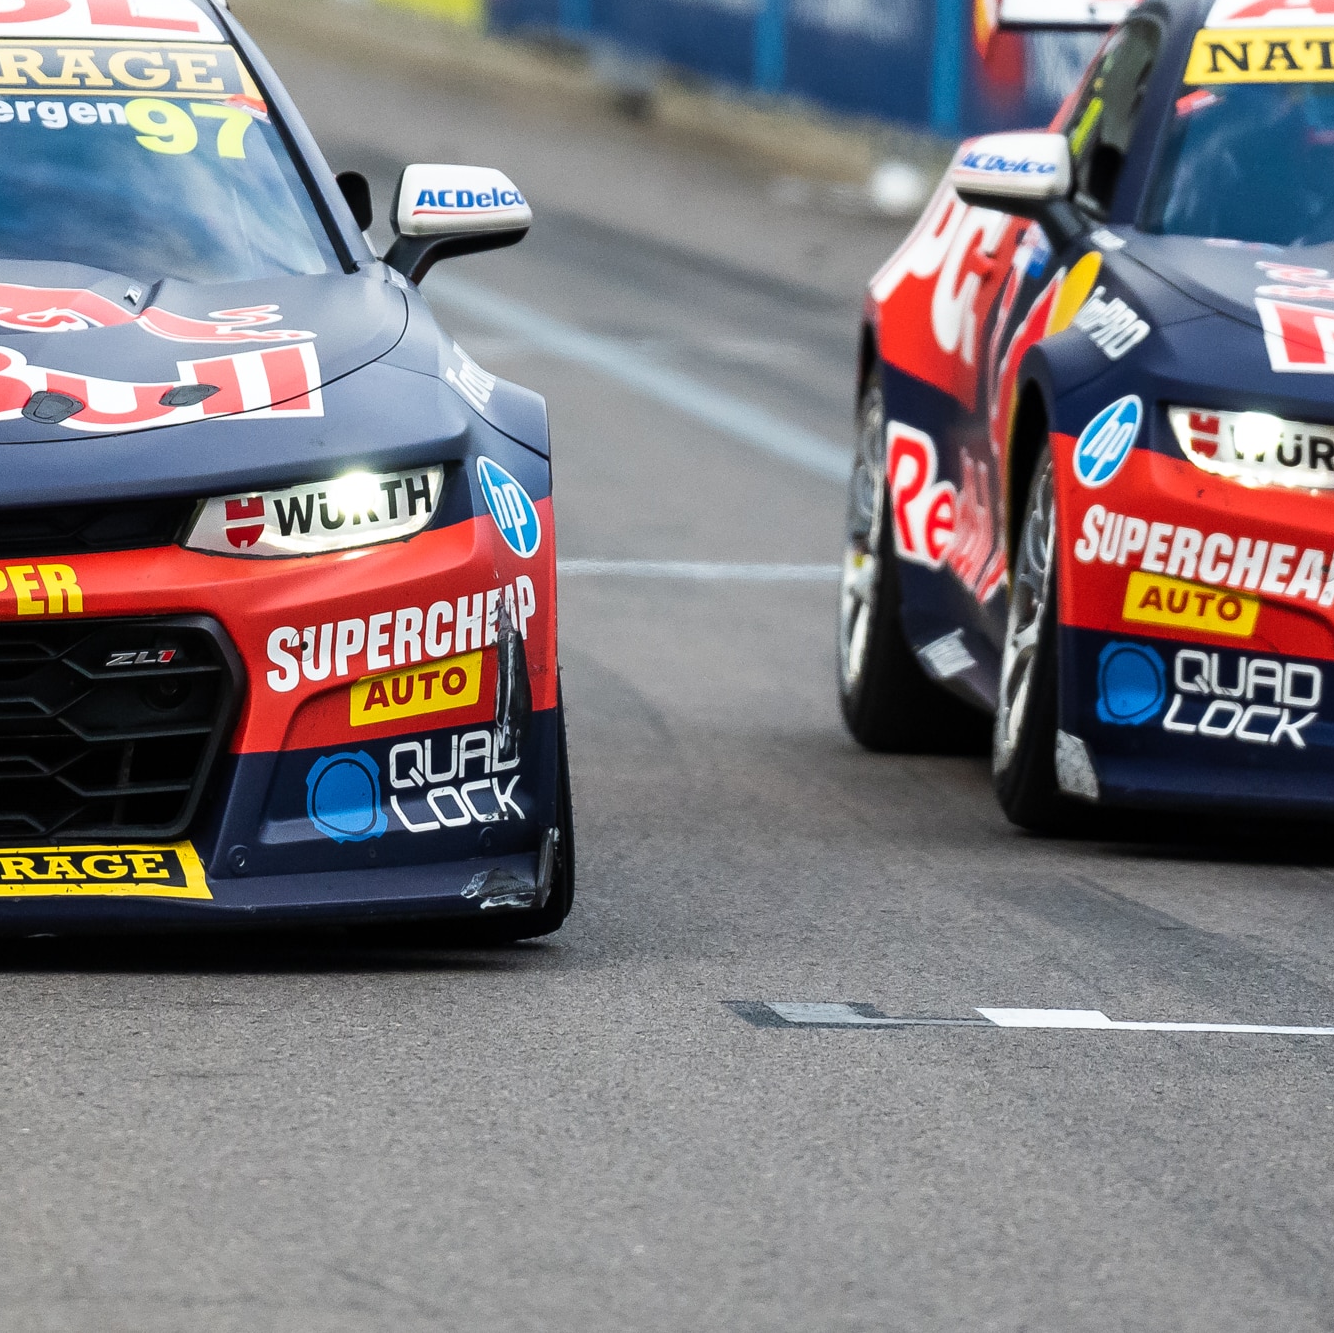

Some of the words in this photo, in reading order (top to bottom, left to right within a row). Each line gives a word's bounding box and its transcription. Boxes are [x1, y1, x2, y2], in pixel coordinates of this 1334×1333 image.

[123, 97, 253, 160] 97
[273, 474, 432, 537] WÜTH
[1138, 585, 1243, 621] AUTO
[106, 649, 176, 667] ZL1
[267, 575, 536, 692] SUPERCHEAP
[362, 666, 468, 712] AUTO
[1174, 649, 1322, 709] QUAD
[1163, 696, 1321, 749] LOCK
[389, 774, 526, 833] LOCK
